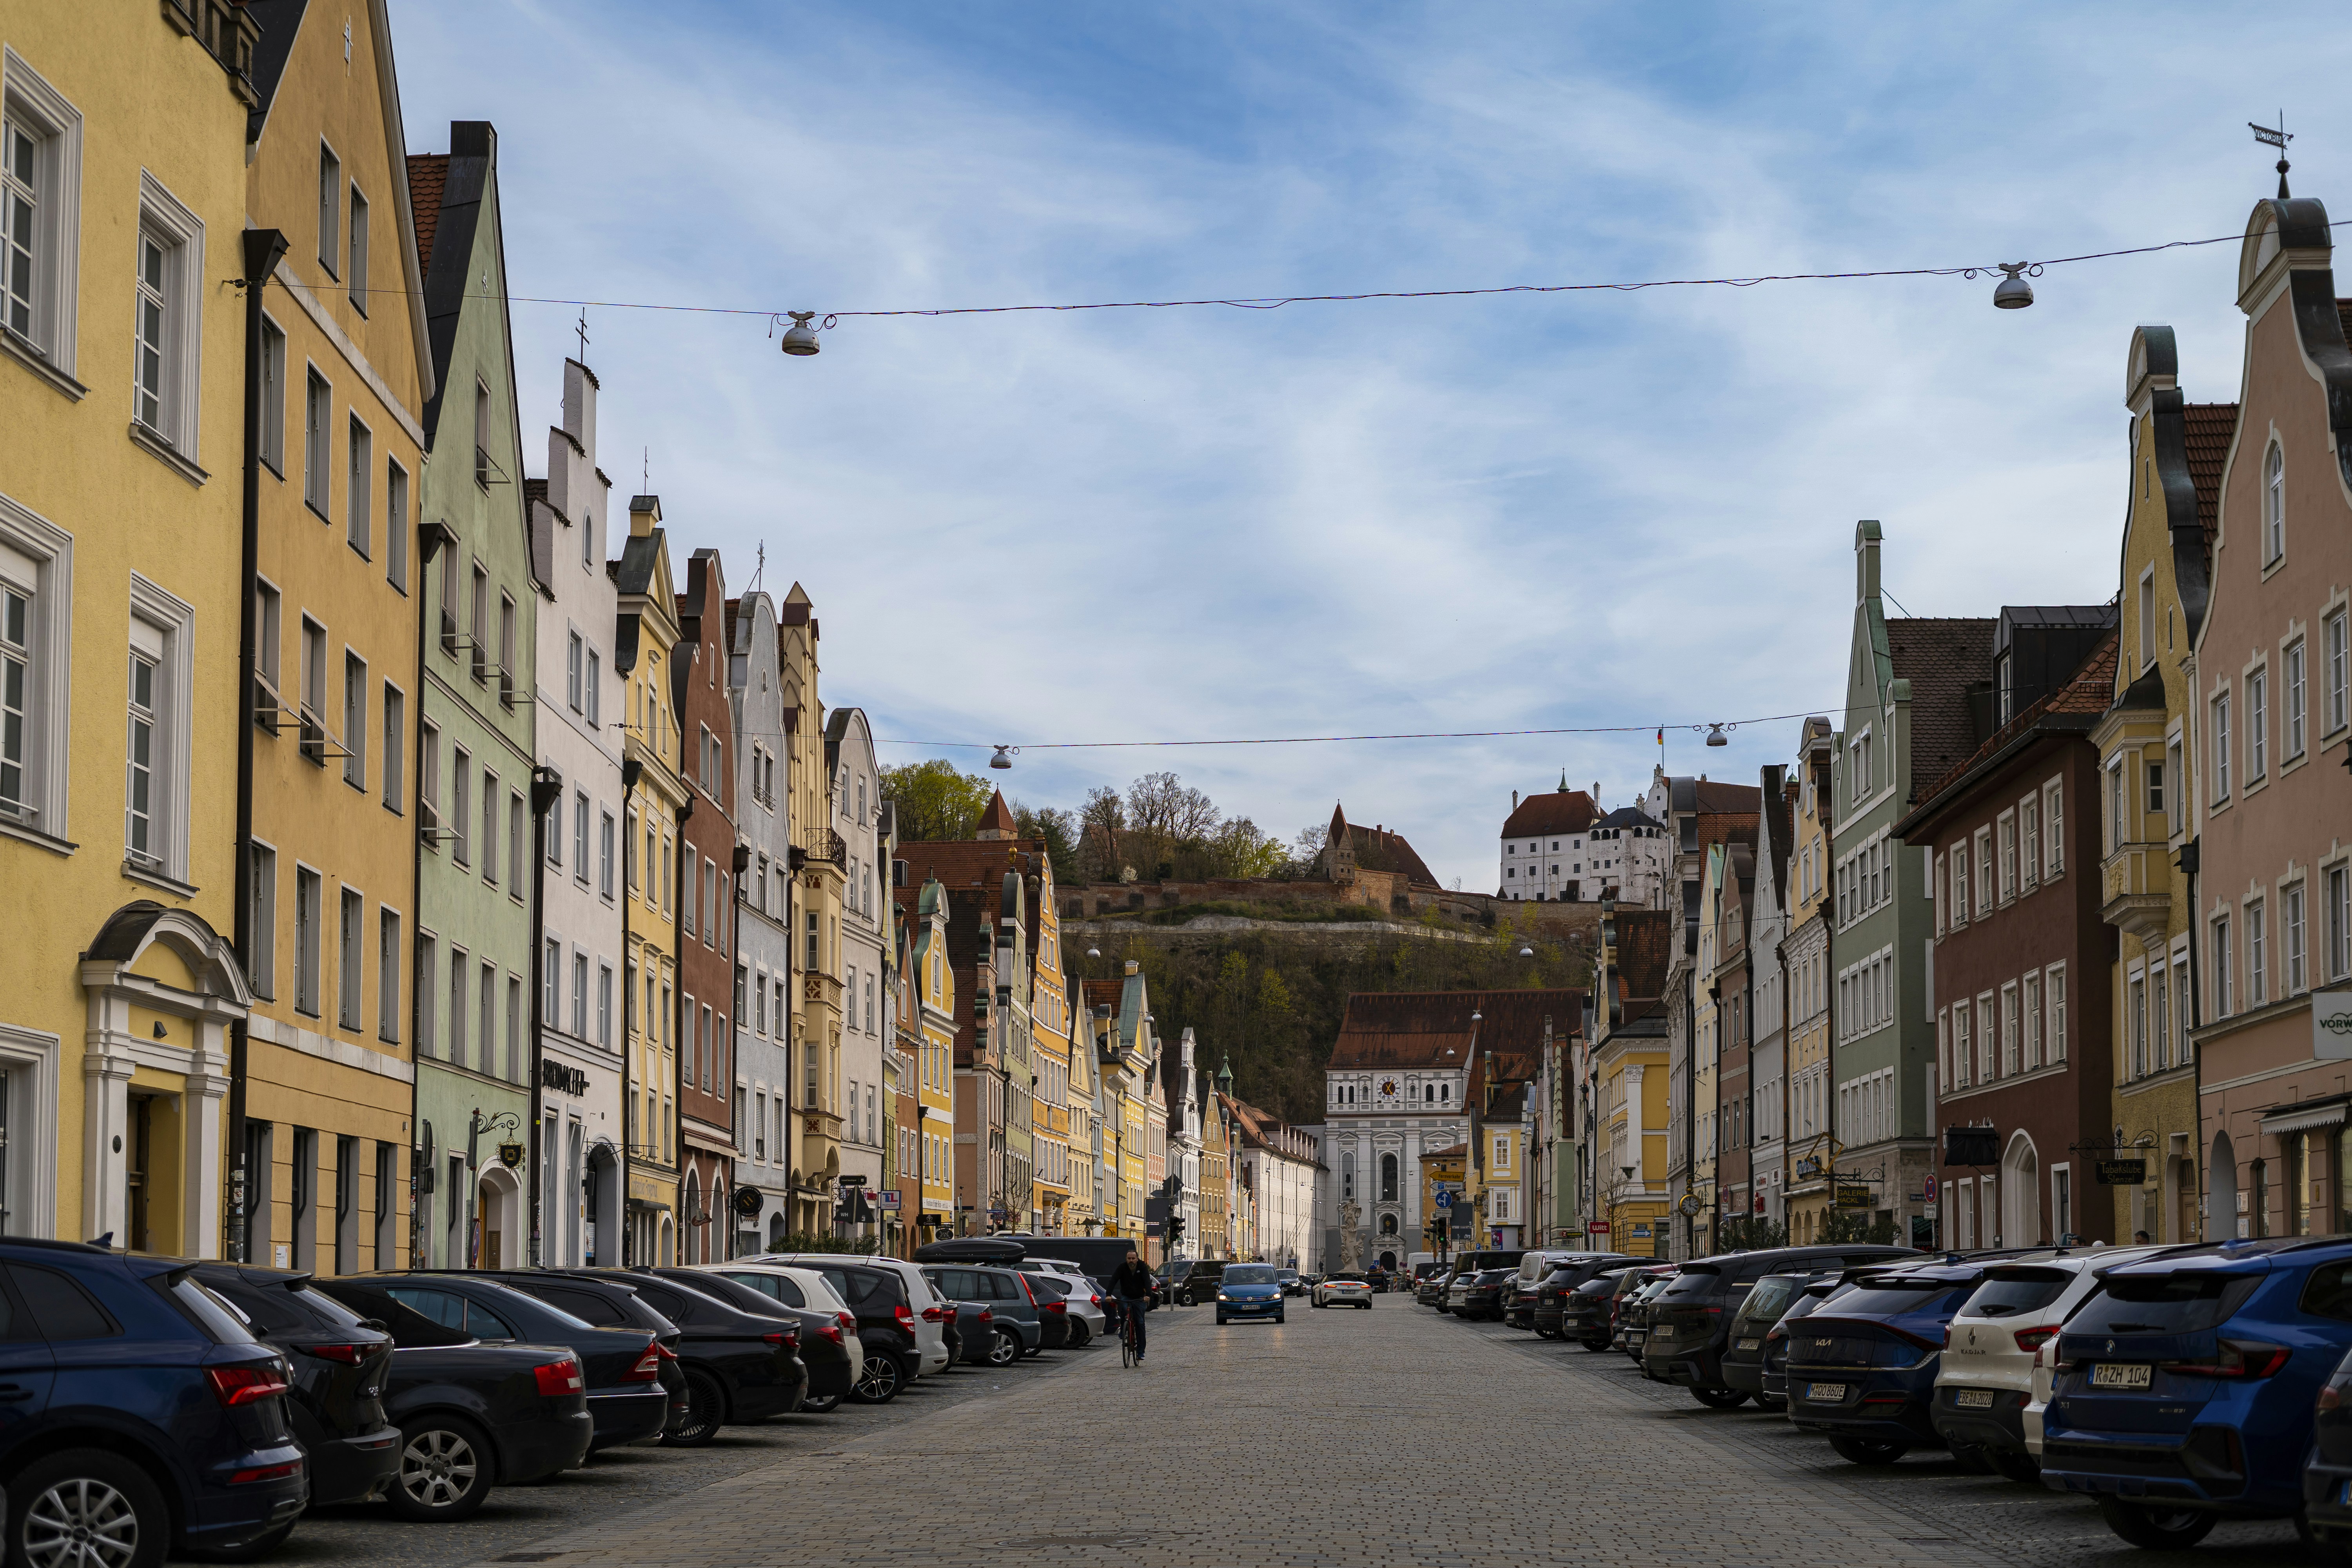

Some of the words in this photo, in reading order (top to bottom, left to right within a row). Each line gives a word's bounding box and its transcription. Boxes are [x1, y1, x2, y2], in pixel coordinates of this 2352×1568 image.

[2108, 1174, 2134, 1183] Stenzel
[2095, 1366, 2103, 1383] R
[2109, 1367, 2123, 1383] ZH
[2127, 1367, 2148, 1384] 104
[1809, 1385, 1816, 1396] M
[1826, 1386, 1844, 1397] 860E
[1958, 1392, 1970, 1405] EBE
[1972, 1392, 1977, 1405] A
[1977, 1393, 1992, 1405] 2028
